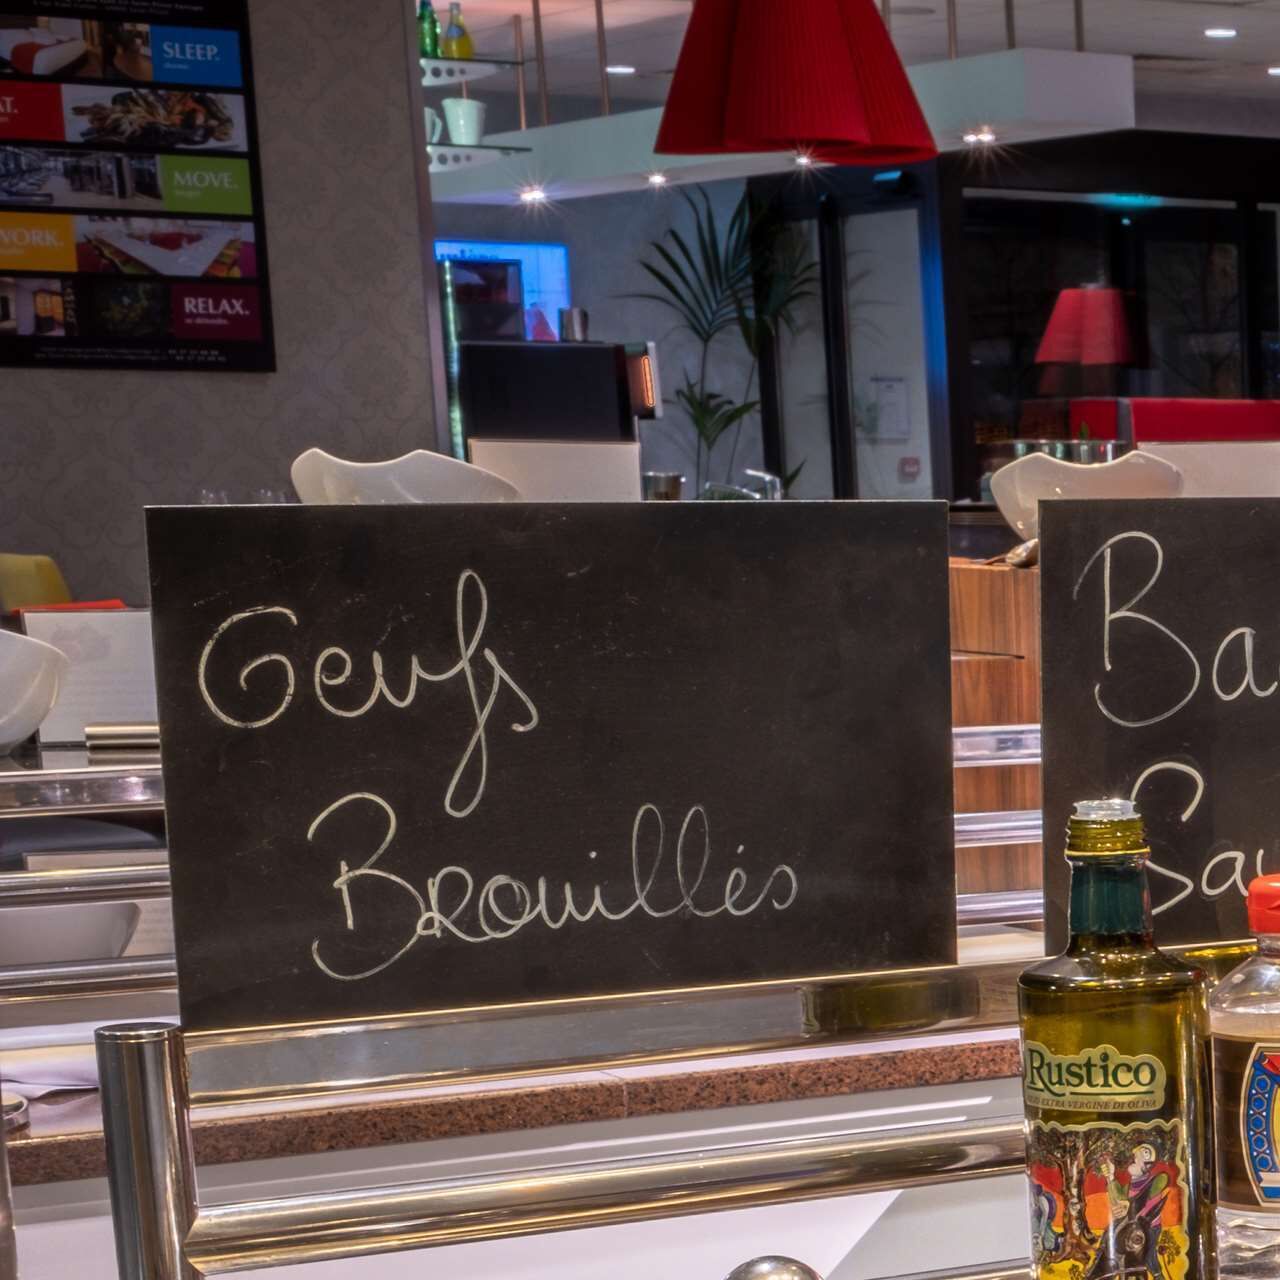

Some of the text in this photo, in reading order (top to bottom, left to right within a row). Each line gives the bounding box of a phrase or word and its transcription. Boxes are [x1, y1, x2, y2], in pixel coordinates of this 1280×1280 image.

[162, 41, 221, 61] SLEEP.
[174, 171, 239, 190] MOVE.
[184, 297, 250, 315] RELAX.
[1028, 1047, 1158, 1098] Rustico
[1068, 1100, 1110, 1110] VERGINE
